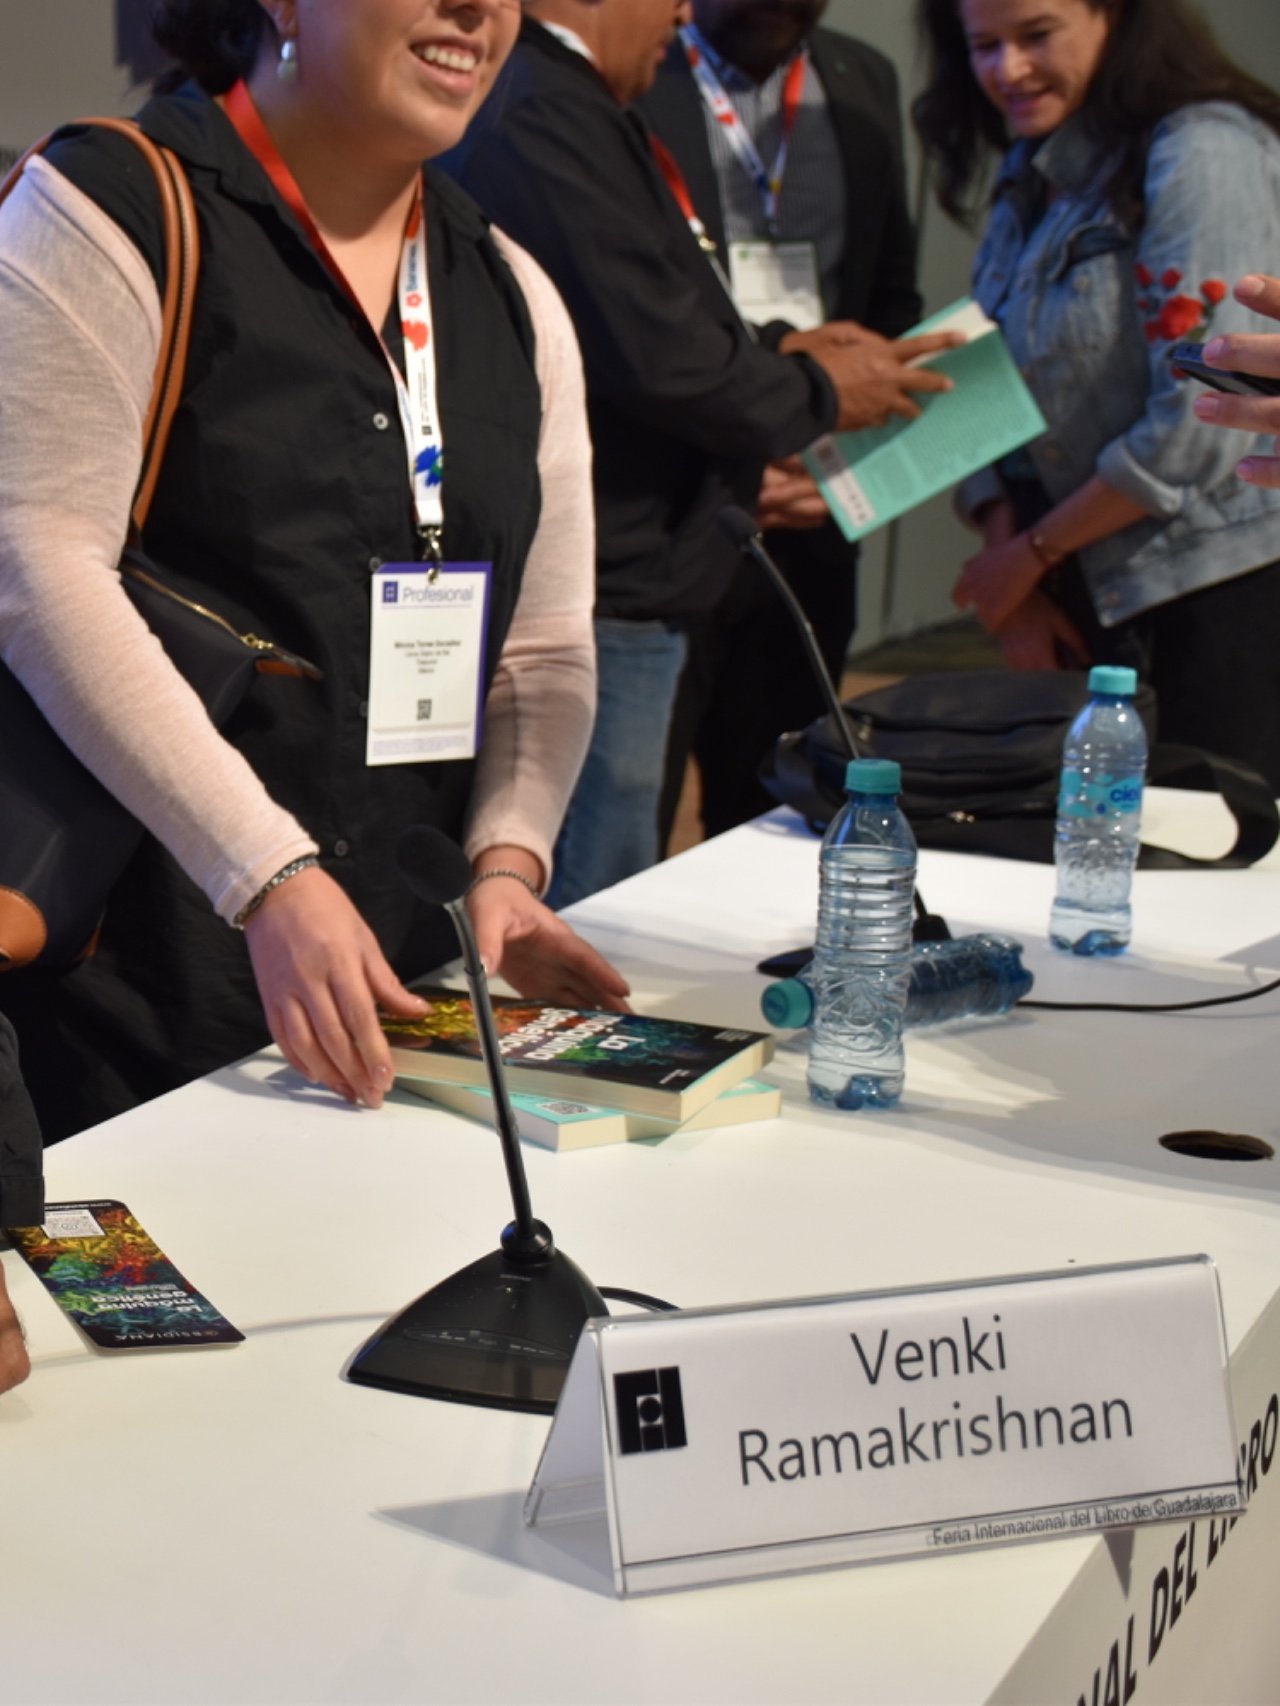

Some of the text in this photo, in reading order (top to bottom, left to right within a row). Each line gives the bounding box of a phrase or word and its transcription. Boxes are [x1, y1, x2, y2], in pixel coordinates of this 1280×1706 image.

[403, 583, 475, 602] Profesional
[849, 1314, 1007, 1386] Venki
[737, 1395, 1133, 1487] Ramakrishnan
[932, 1491, 1238, 1546] Feria Internacional del Libro de Guadalajara
[1148, 1520, 1197, 1667] DEL
[1207, 1393, 1279, 1569] LRO
